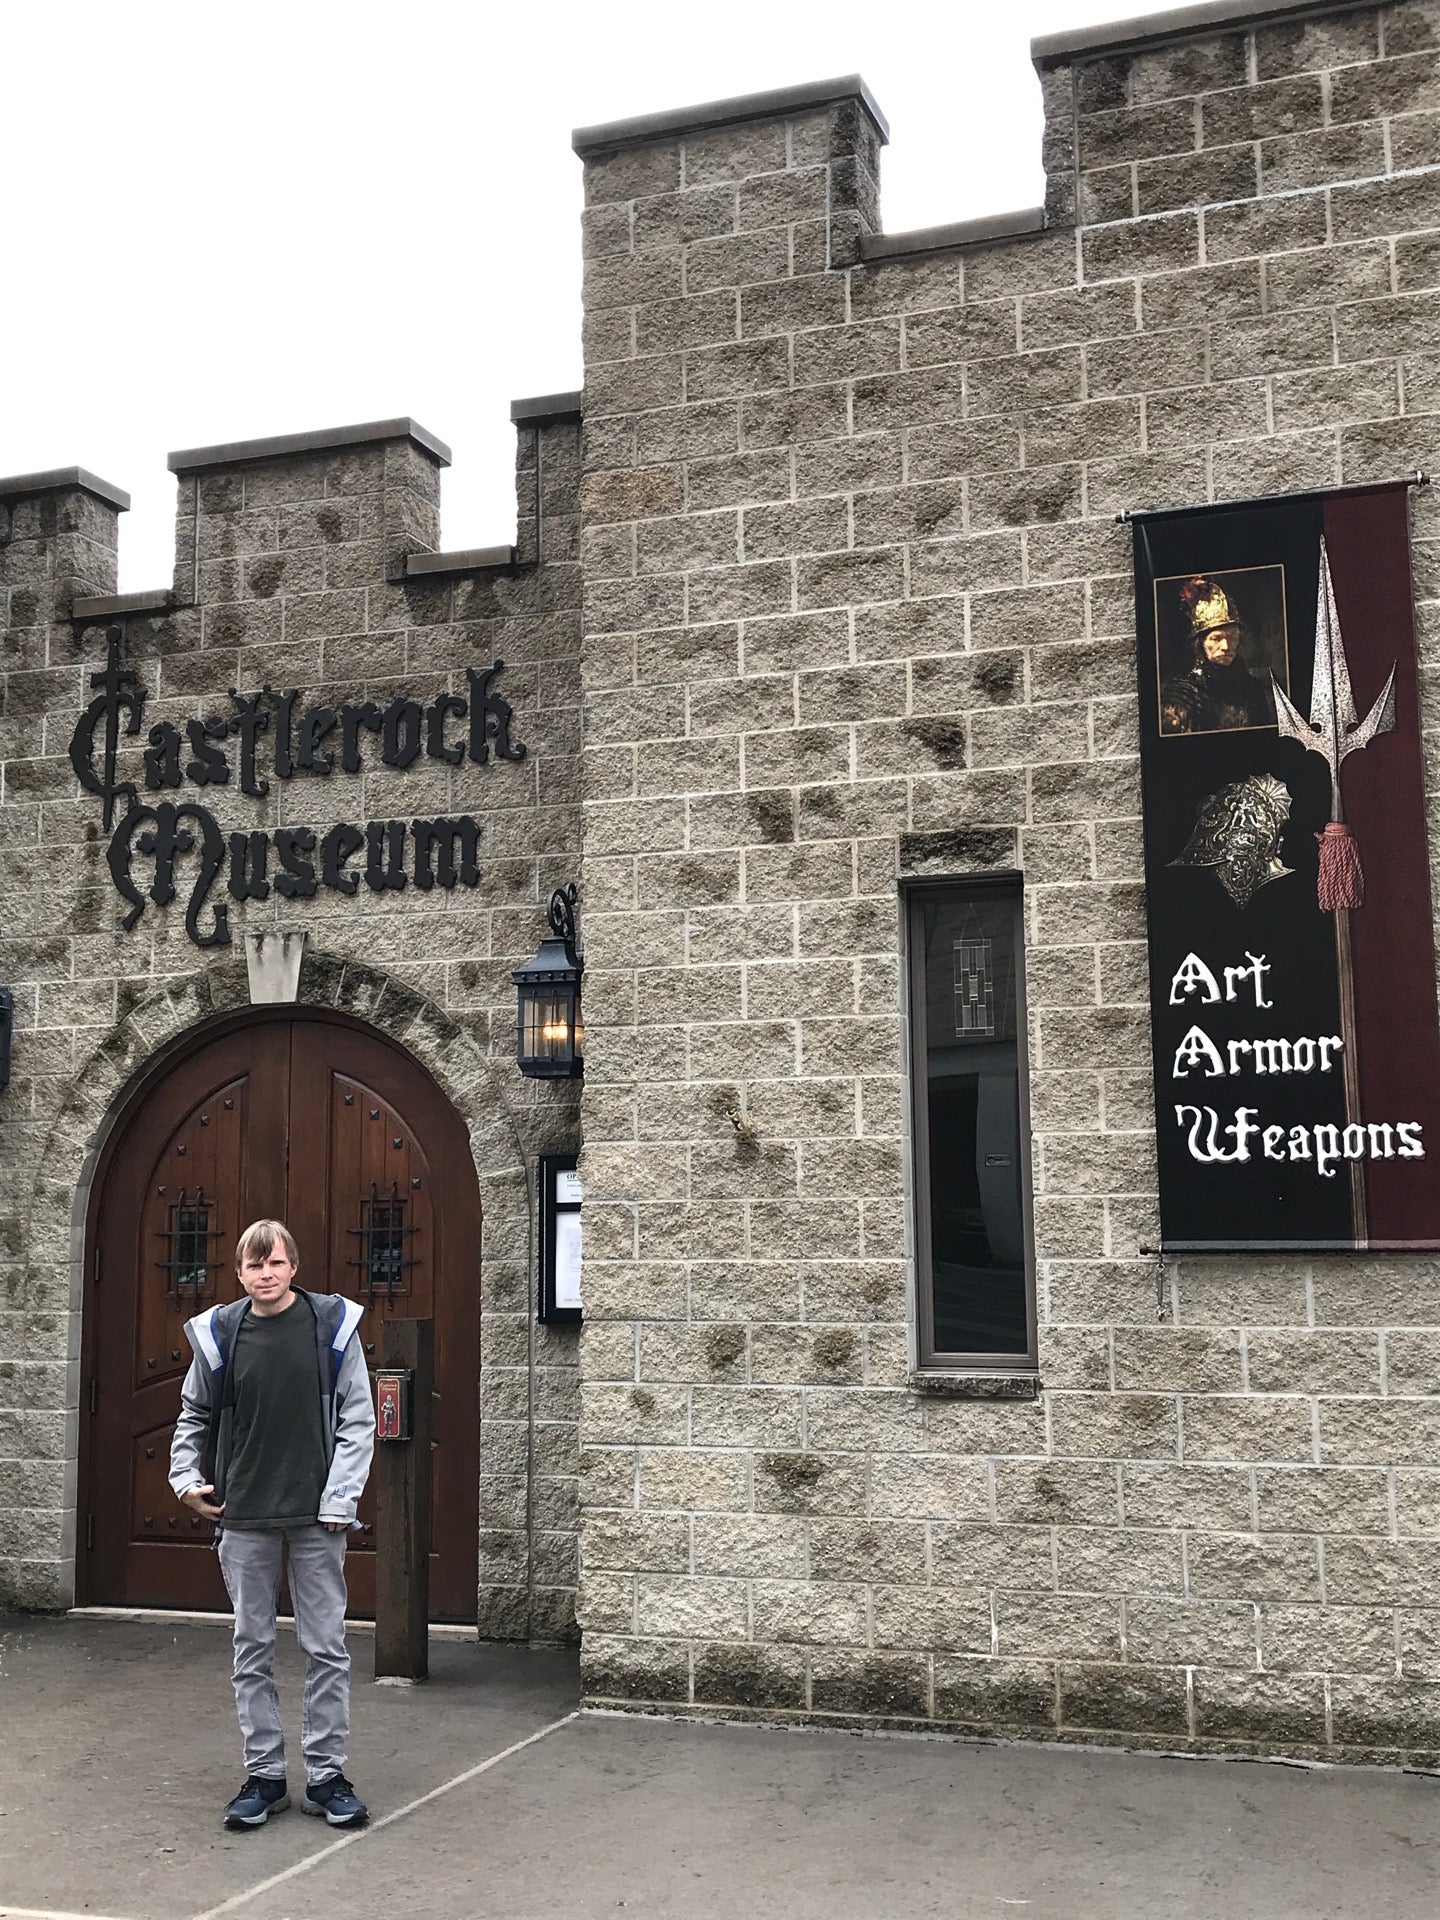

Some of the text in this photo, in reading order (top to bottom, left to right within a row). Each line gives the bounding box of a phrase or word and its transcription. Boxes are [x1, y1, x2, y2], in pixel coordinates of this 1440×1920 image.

[70, 627, 526, 830] Castlerock
[107, 802, 482, 946] Museum
[1169, 951, 1273, 1008] Art
[1172, 1024, 1344, 1078] Armor
[1174, 1104, 1426, 1177] Weapons
